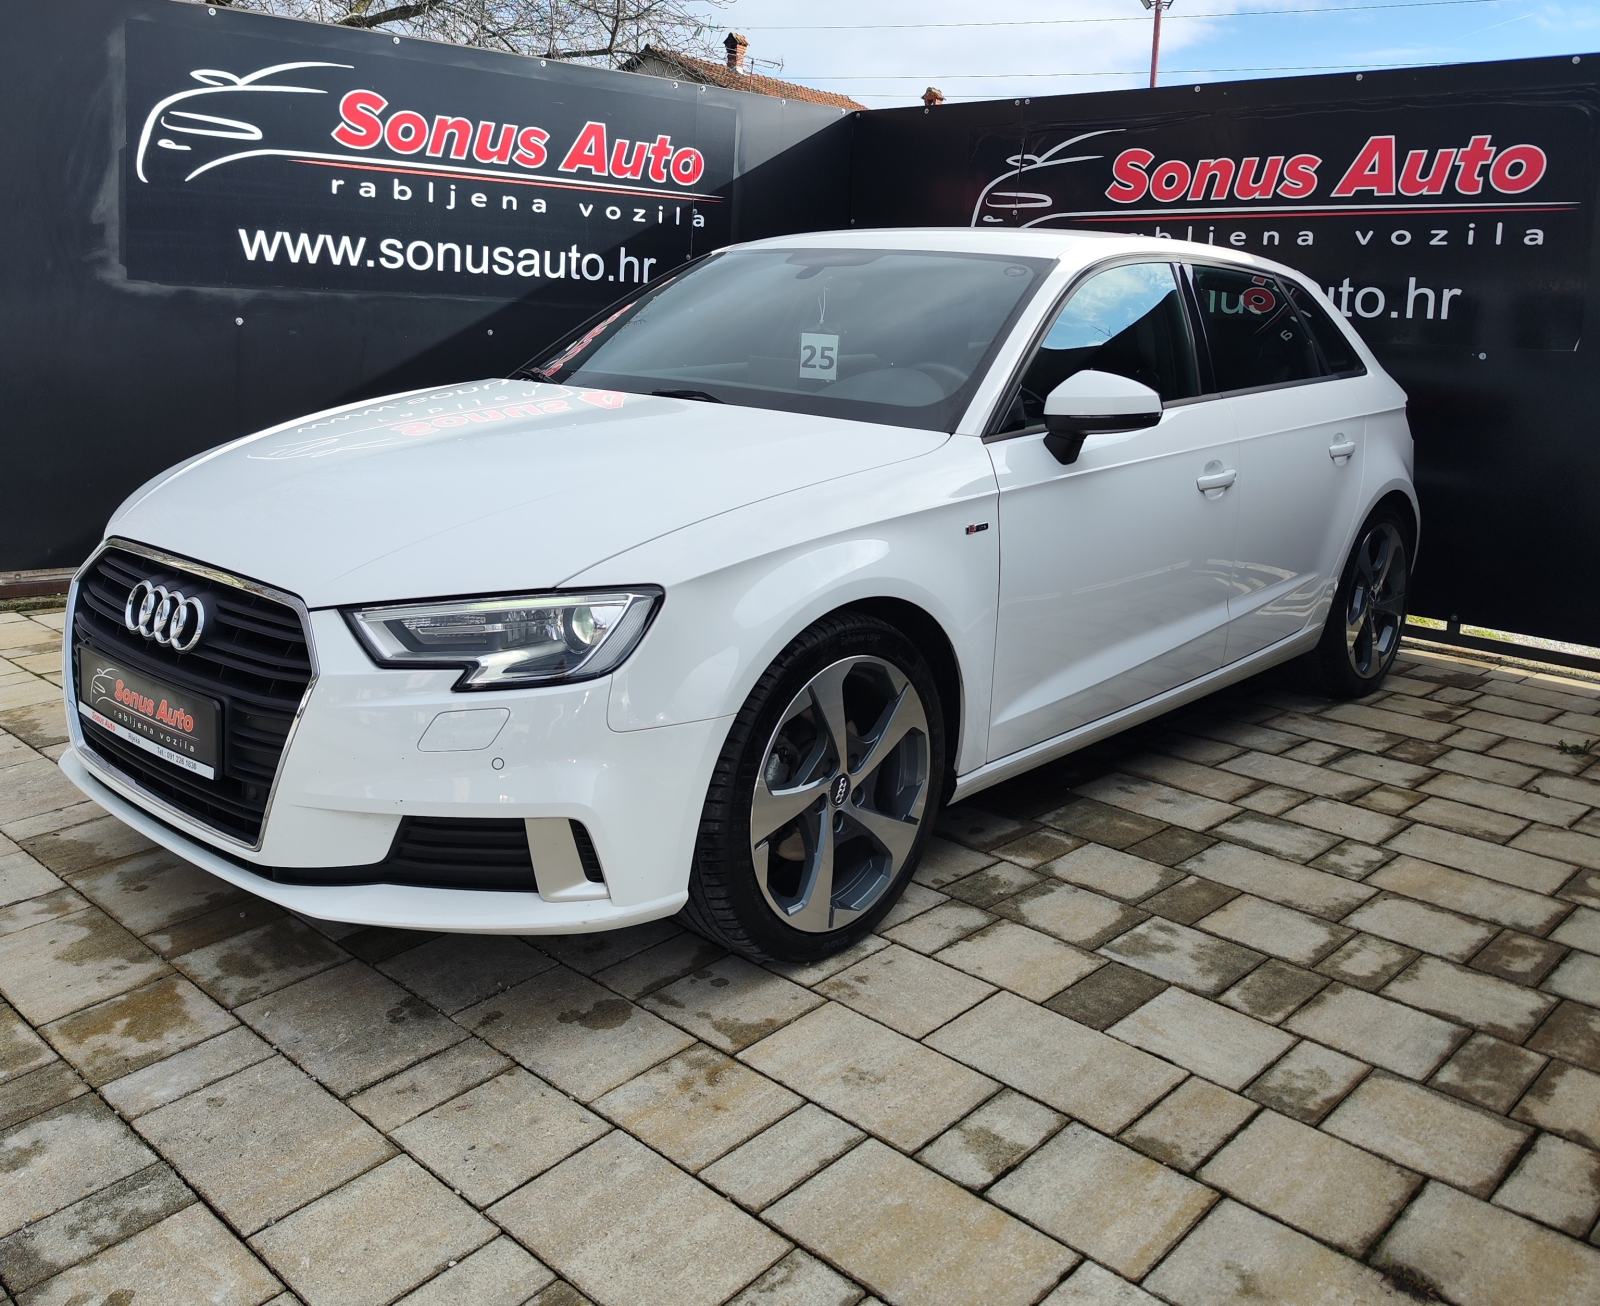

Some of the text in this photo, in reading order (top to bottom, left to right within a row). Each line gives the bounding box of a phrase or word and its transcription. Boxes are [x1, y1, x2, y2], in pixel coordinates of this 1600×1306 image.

[332, 88, 705, 187] Sonus Auto
[1105, 134, 1547, 204] Sonus Auto
[330, 175, 705, 229] rabljena vozila
[238, 227, 657, 284] www.sonusauto.hr
[1355, 222, 1545, 247] vozila
[801, 344, 835, 370] 25
[113, 709, 195, 753] rabljena vozila
[114, 678, 194, 732] Sonus Auto
